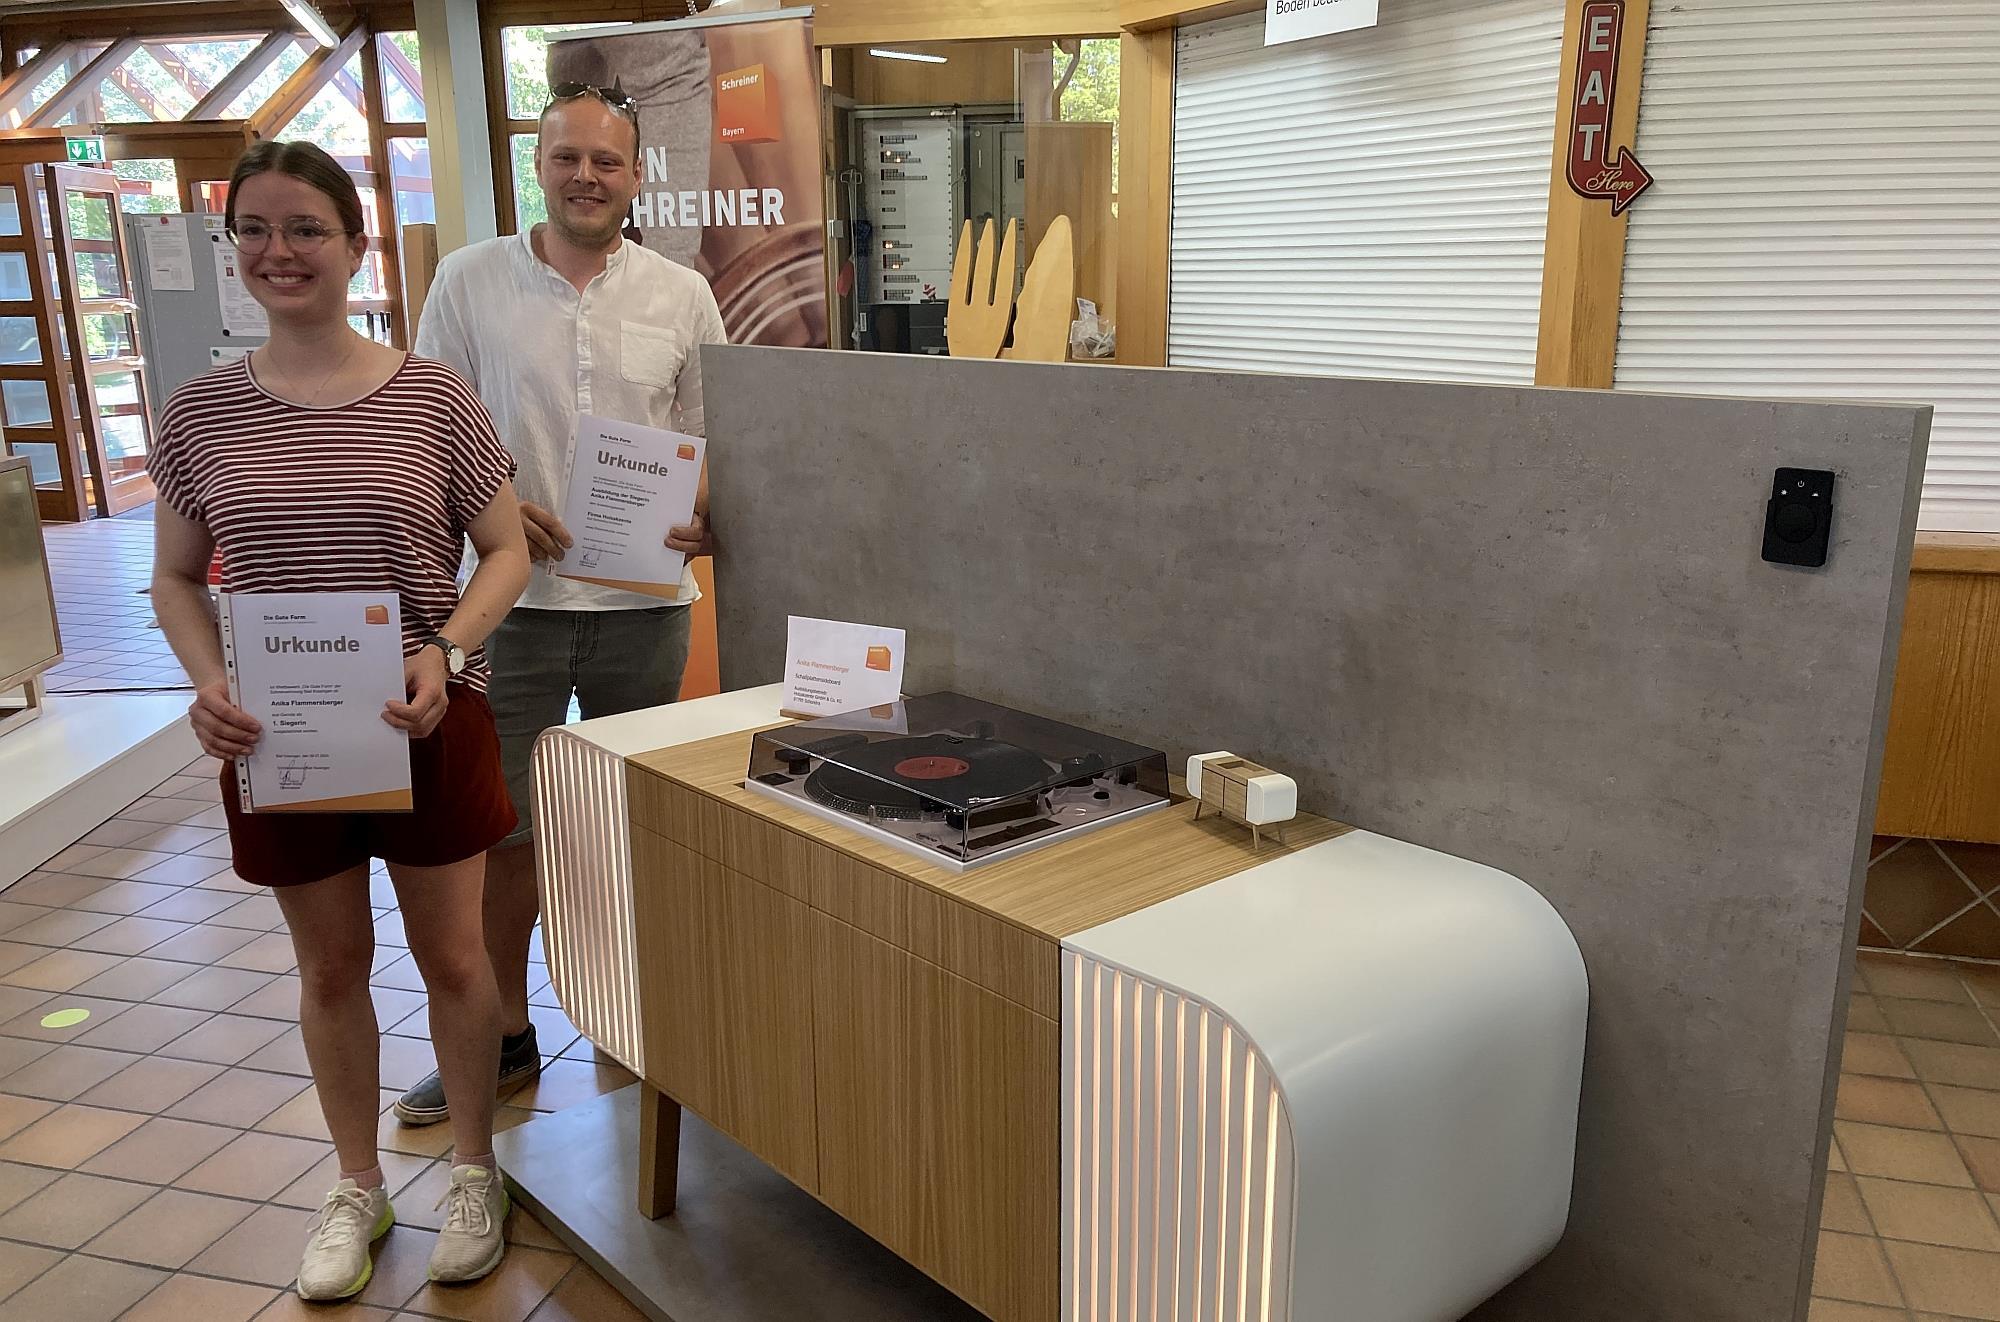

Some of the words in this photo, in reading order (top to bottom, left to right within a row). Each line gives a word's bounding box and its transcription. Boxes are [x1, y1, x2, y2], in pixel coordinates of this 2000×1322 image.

[721, 73, 759, 91] Schreiner
[1579, 16, 1612, 161] EAT
[722, 126, 745, 138] Bayern
[1586, 170, 1635, 191] Here
[622, 188, 785, 228] HREINER
[597, 450, 669, 477] Urkunde
[264, 635, 361, 654] Urkunde
